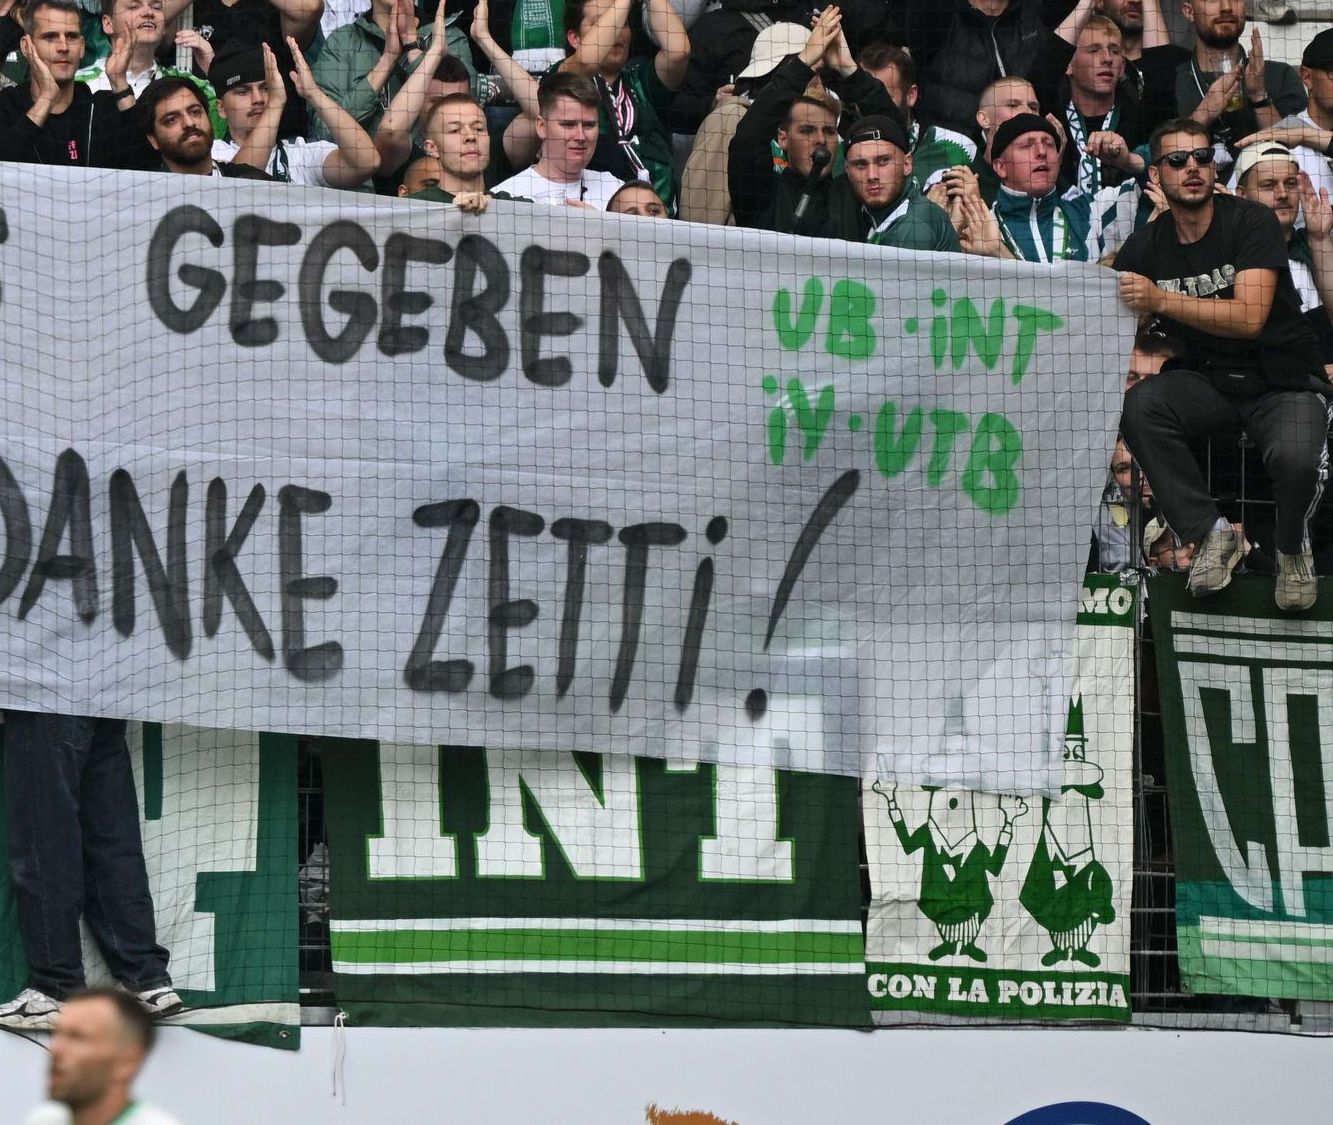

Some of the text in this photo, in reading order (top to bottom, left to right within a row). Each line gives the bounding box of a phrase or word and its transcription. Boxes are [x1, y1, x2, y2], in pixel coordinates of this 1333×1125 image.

[146, 204, 692, 395] GEGEBEN
[867, 973, 1128, 1008] CON LA POLIZIA
